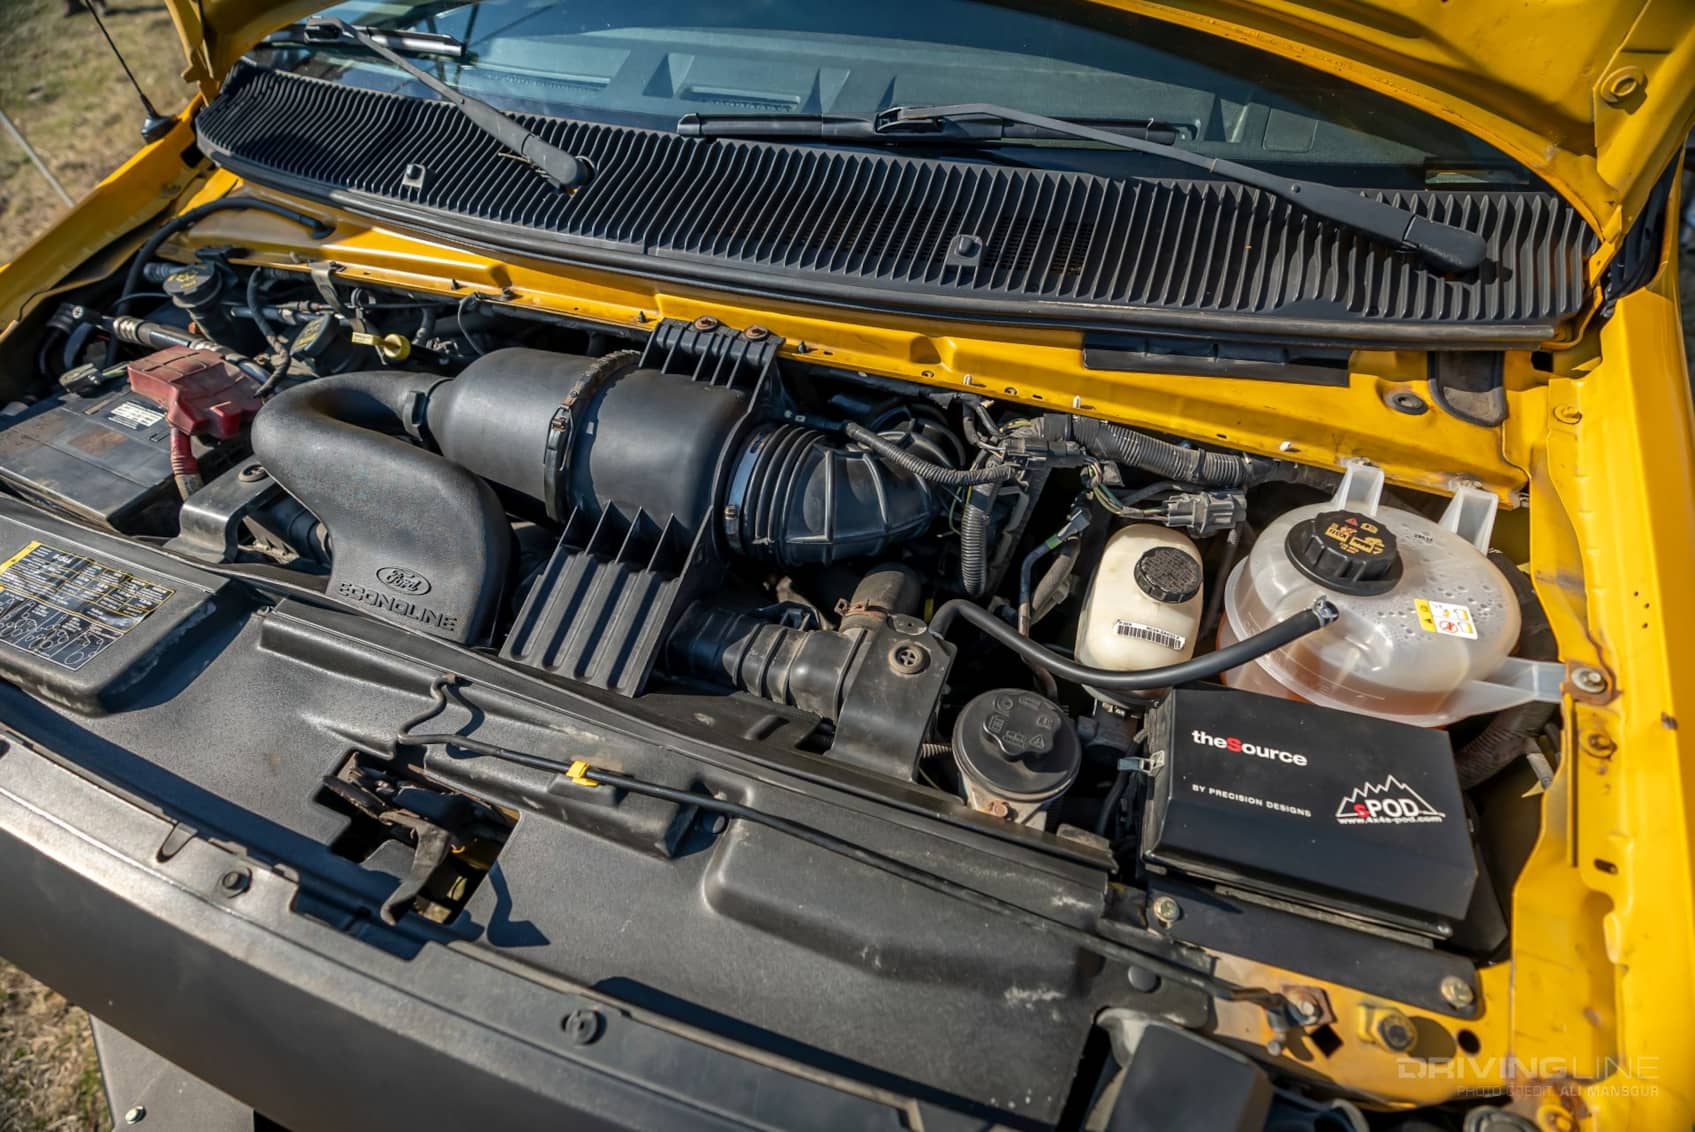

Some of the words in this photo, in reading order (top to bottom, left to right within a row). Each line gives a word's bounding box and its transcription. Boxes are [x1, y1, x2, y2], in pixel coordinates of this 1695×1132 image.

[386, 569, 422, 592] Ford
[337, 582, 458, 632] ECONOLINE
[1191, 783, 1206, 793] BY
[1208, 787, 1263, 807] PRECISION
[1265, 800, 1312, 818] DESIGNS
[1352, 798, 1420, 819] sPOD
